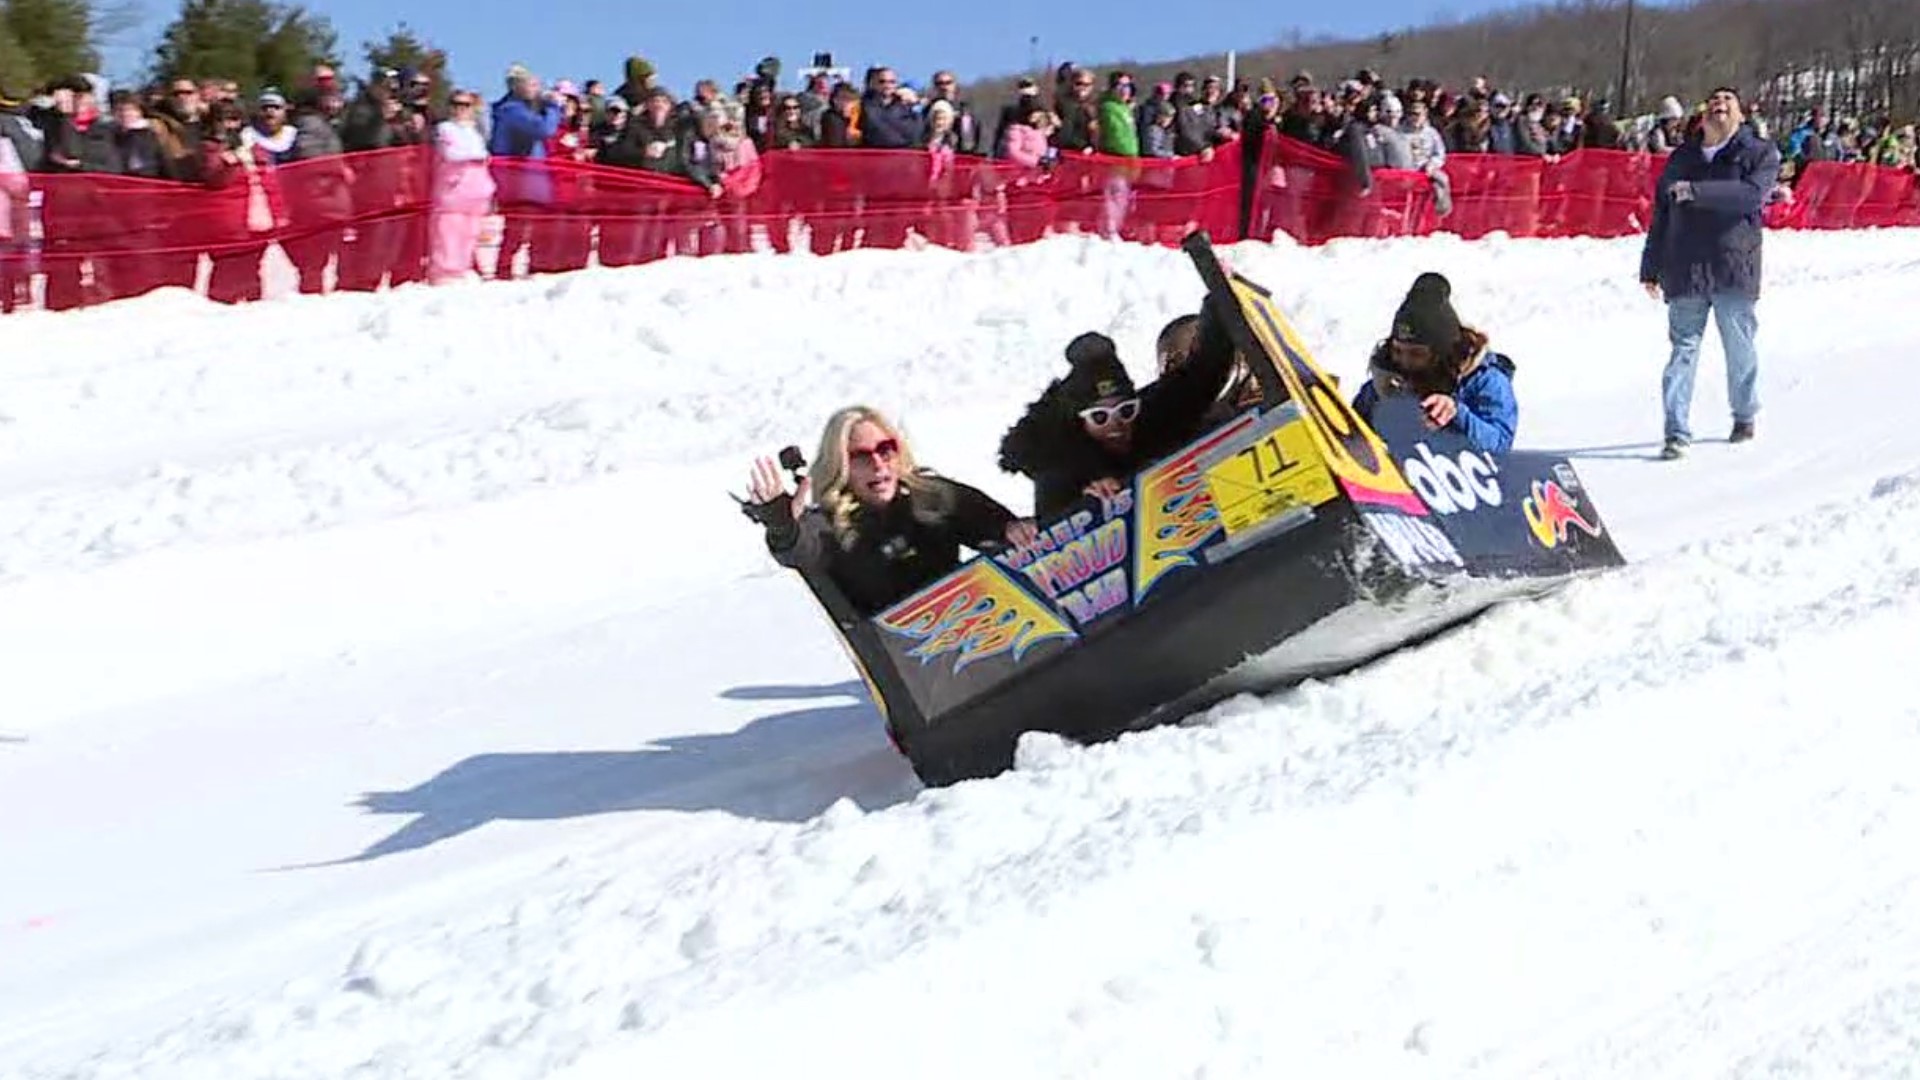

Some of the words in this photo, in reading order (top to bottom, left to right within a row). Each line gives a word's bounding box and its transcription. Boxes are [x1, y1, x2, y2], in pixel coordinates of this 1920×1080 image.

[1237, 436, 1300, 484] 71
[1404, 441, 1502, 515] abc
[1020, 517, 1127, 599] PROUD
